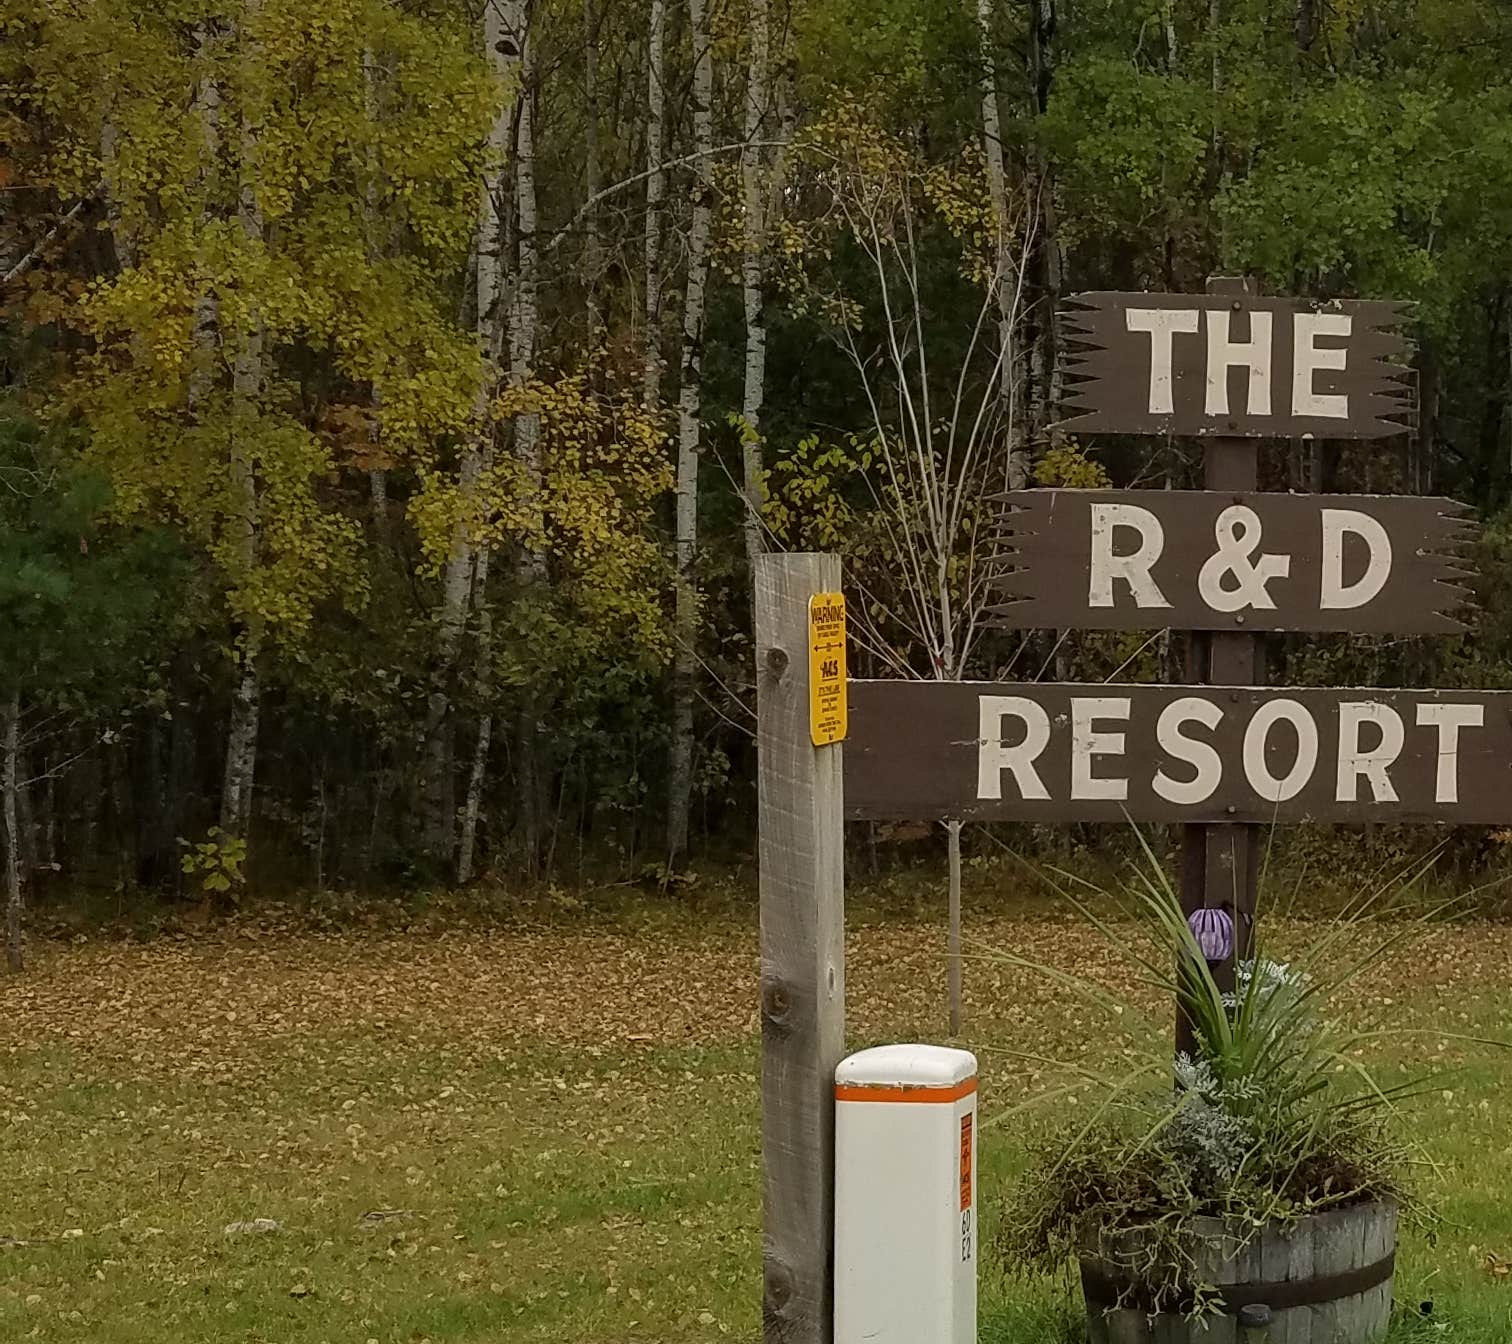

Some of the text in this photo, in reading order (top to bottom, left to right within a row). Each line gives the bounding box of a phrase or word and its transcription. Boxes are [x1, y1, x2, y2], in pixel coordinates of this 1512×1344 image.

[1126, 308, 1352, 419] THE
[811, 604, 844, 624] WARNING
[977, 696, 1484, 804] RESORT
